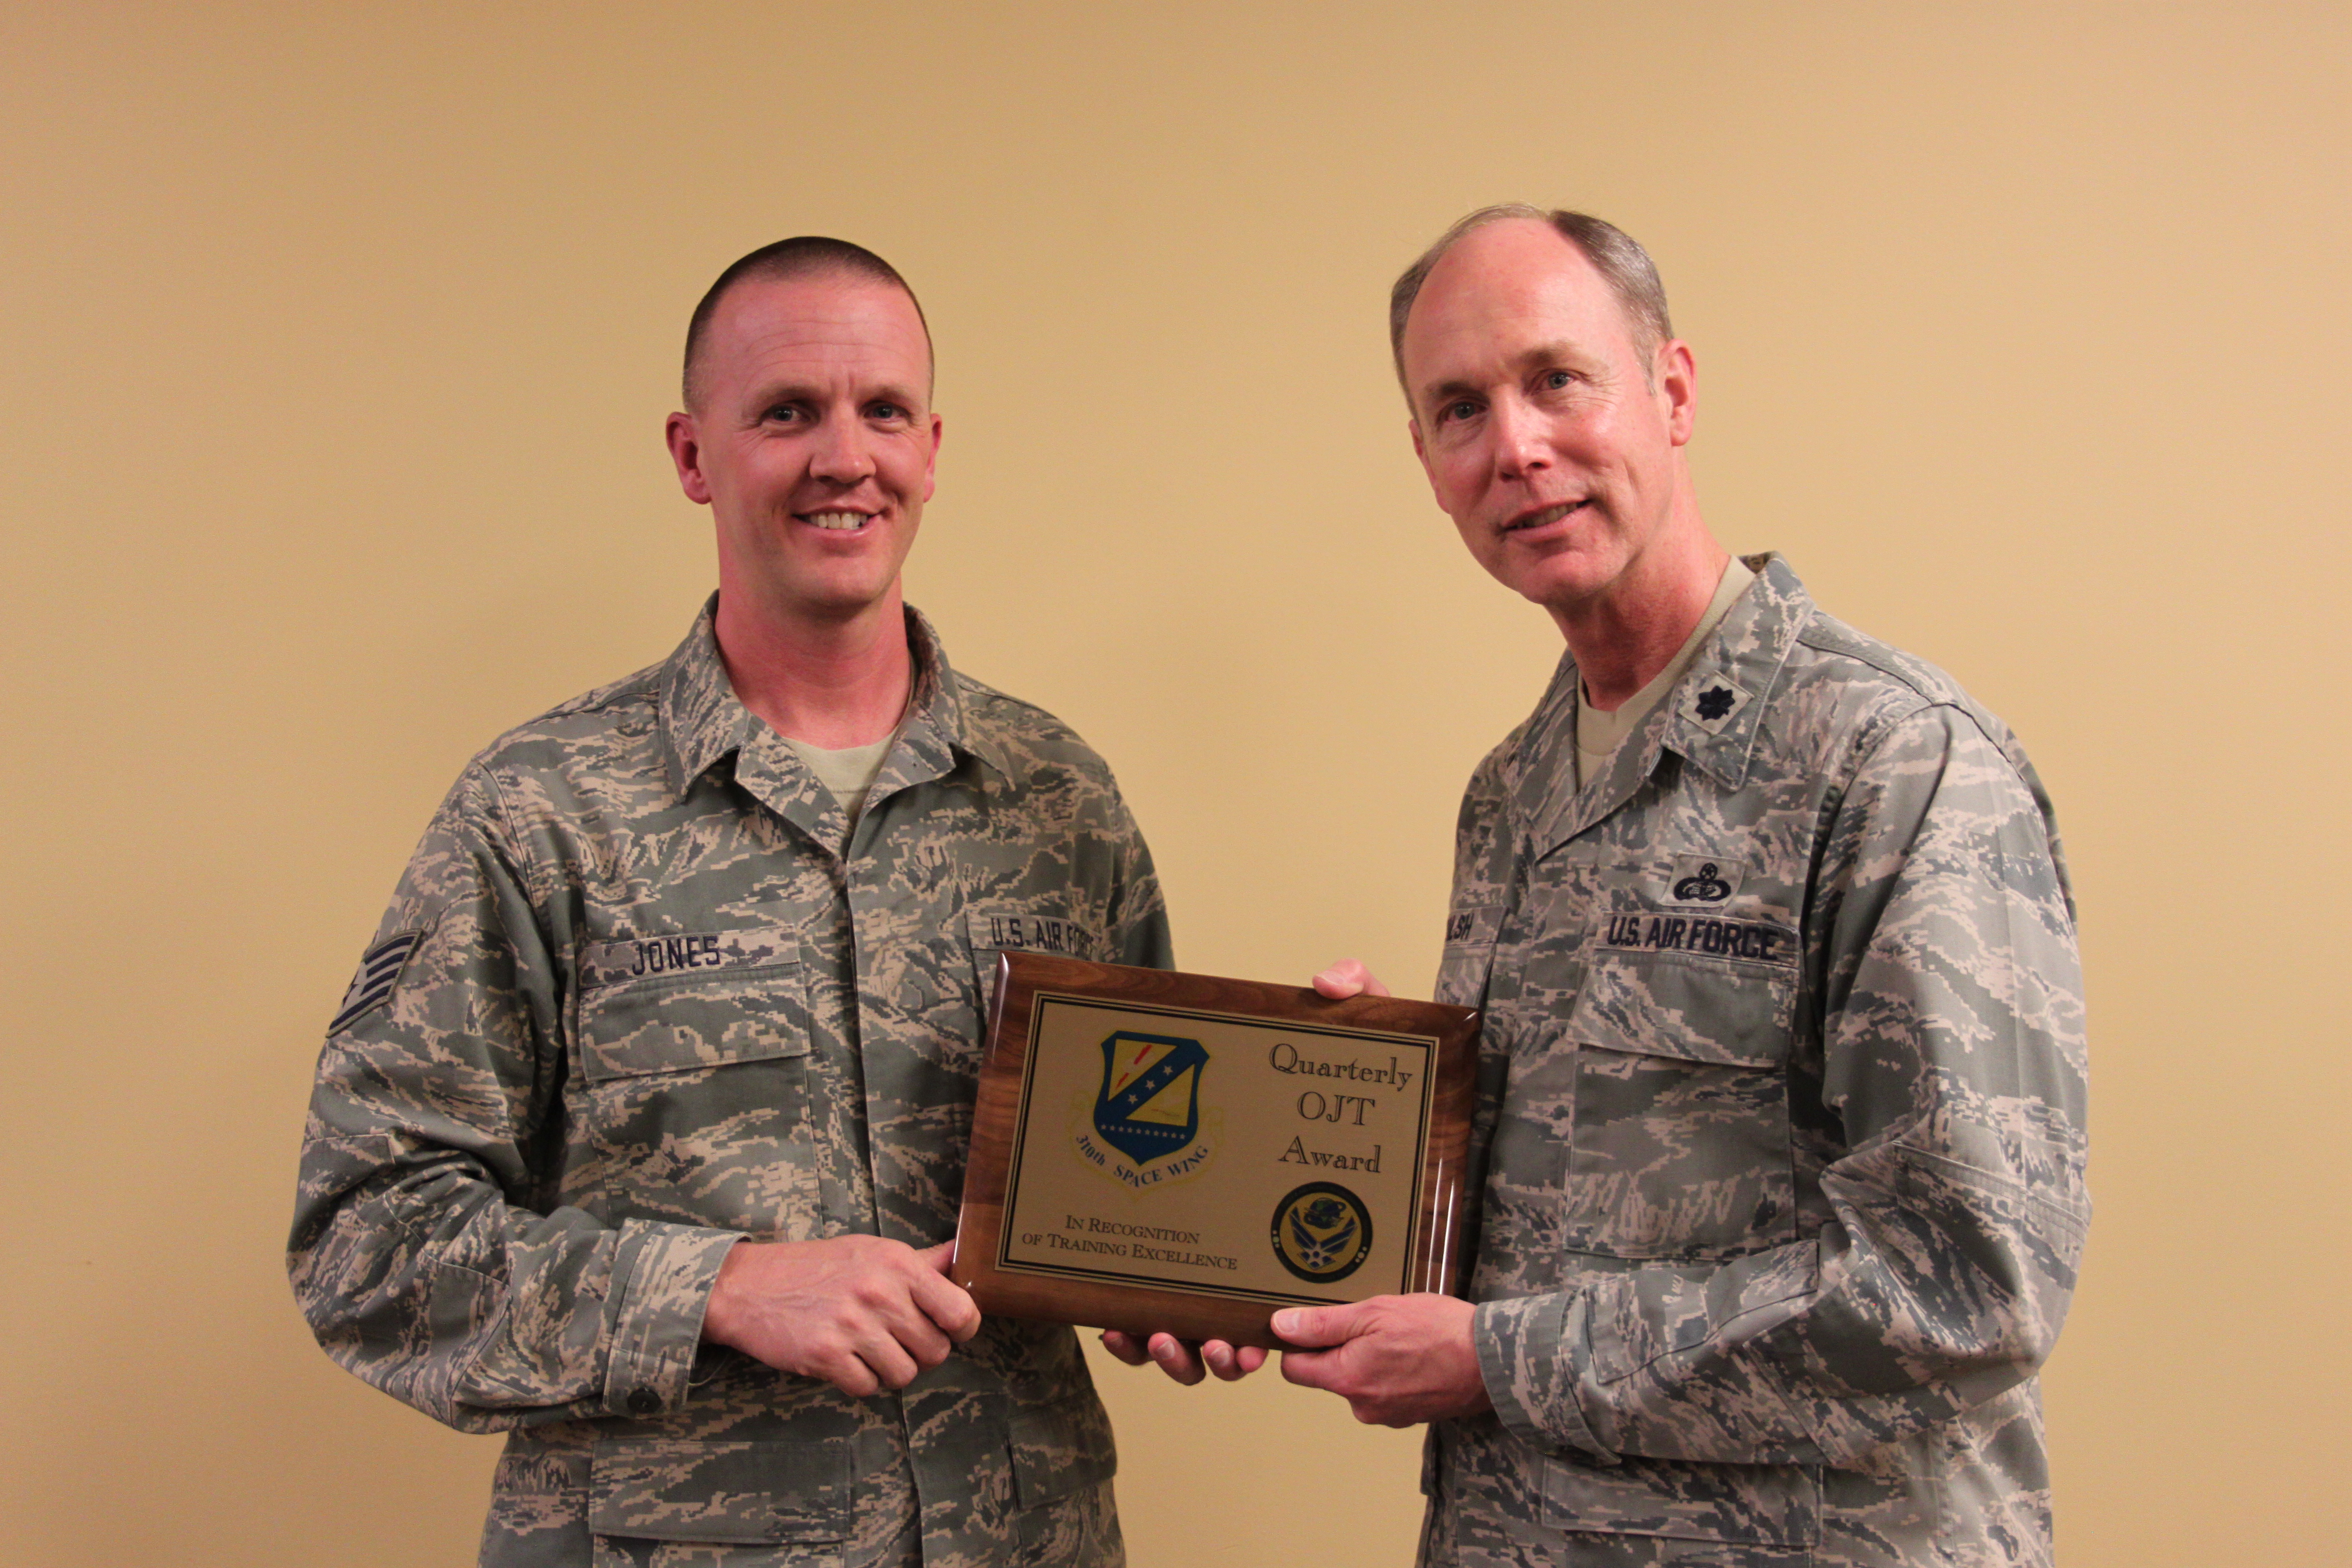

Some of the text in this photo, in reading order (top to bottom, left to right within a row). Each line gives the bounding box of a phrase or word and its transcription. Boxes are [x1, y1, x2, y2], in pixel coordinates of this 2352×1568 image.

[991, 917, 1032, 947] U.S.
[1036, 920, 1064, 951] AIR
[1446, 912, 1474, 941] LSH
[1607, 916, 1779, 960] U.S. AIR FORCE
[632, 935, 720, 975] JONES
[1269, 1043, 1413, 1092] Quarterly
[1297, 1091, 1375, 1126] OJT
[1076, 1134, 1208, 1187] 310th SPACE WING
[1277, 1135, 1381, 1173] Award
